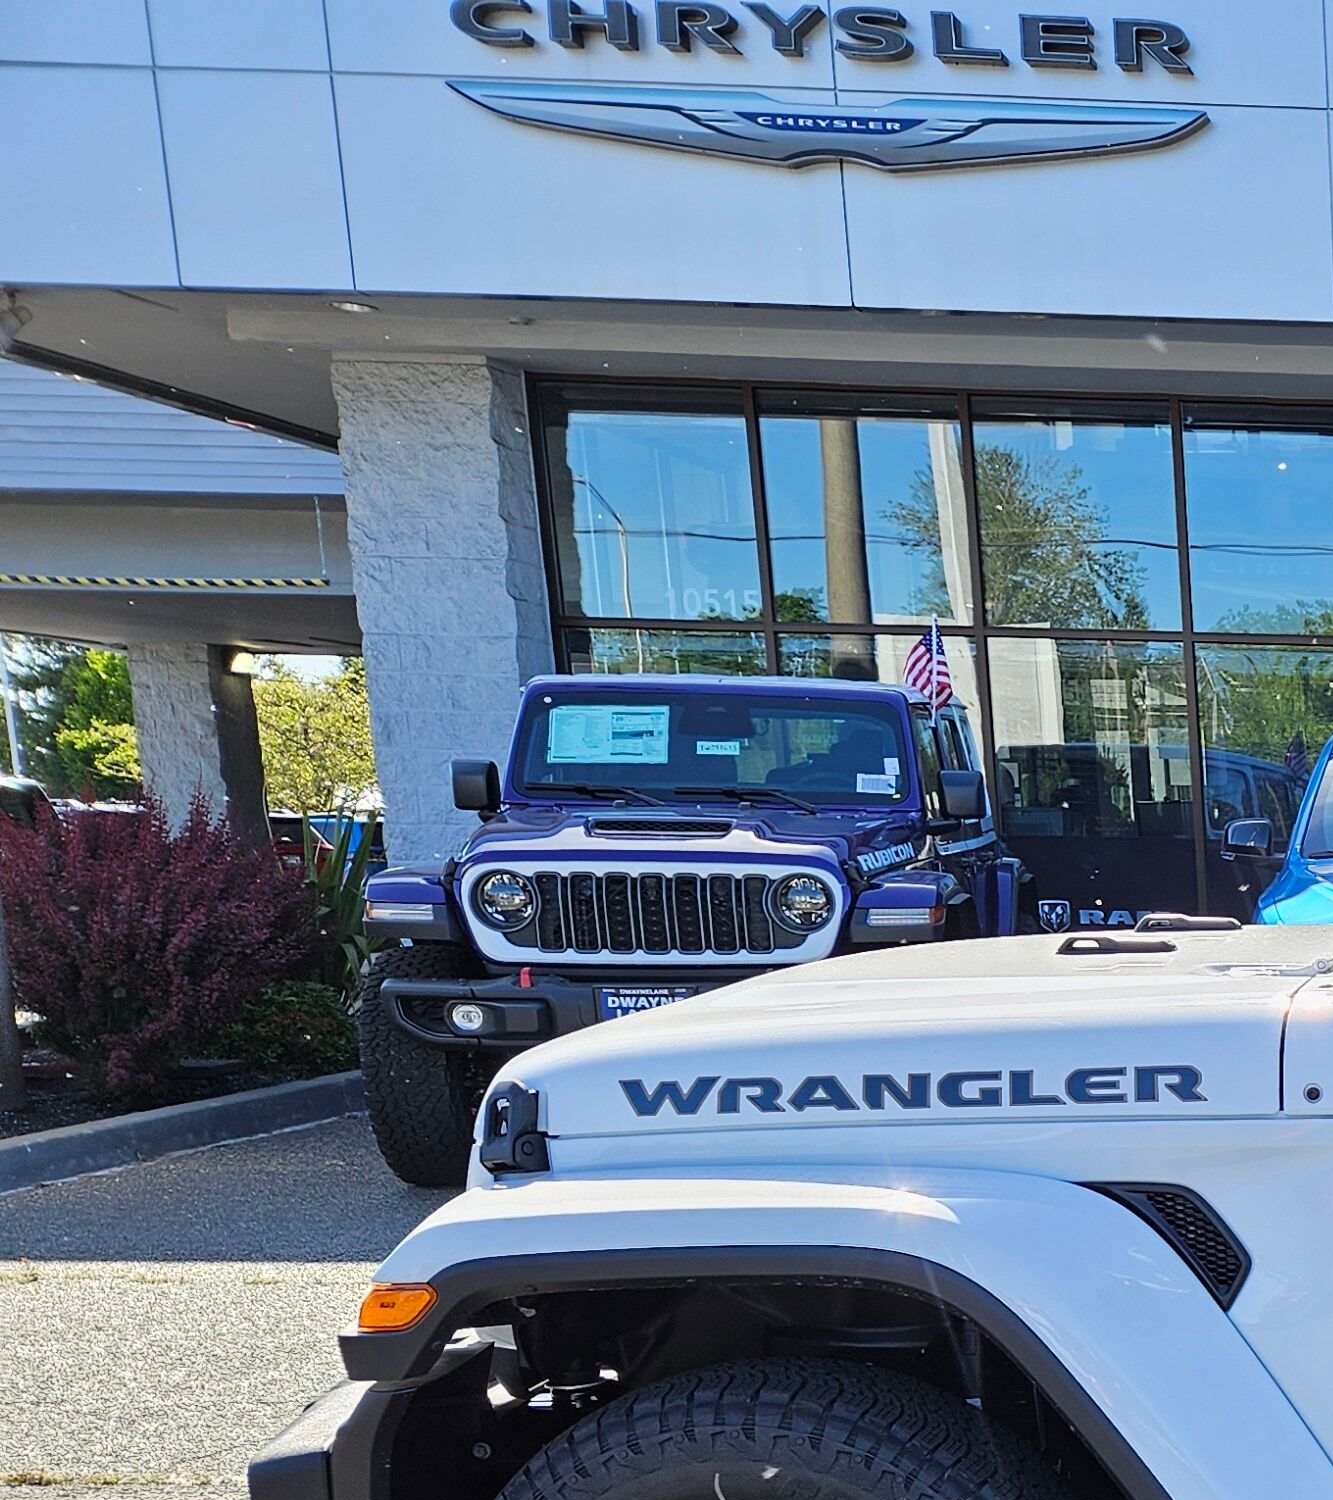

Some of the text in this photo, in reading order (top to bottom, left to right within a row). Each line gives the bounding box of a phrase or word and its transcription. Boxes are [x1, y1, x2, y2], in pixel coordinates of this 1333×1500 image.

[449, 0, 1194, 76] CHRYSLER
[757, 116, 901, 130] CHRYSLER
[664, 587, 760, 621] 10515
[857, 842, 915, 872] RUBICON
[1079, 909, 1152, 925] RA
[618, 1064, 1208, 1117] WRANGLER
